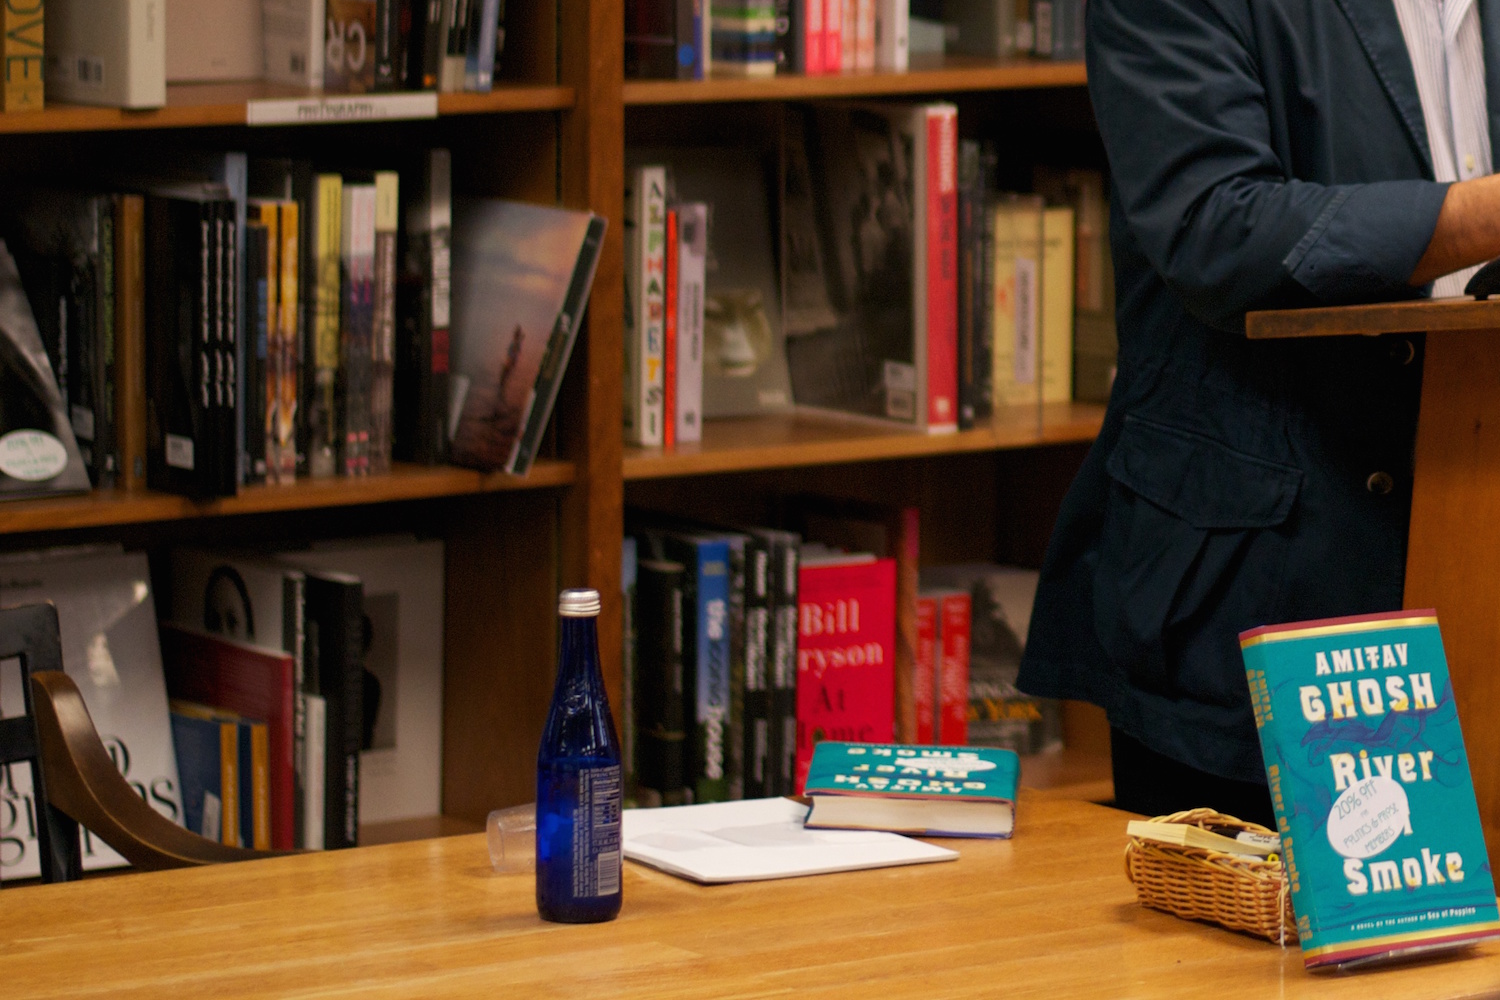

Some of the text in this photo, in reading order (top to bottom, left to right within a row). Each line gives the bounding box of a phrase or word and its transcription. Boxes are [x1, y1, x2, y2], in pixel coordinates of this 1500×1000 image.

[799, 598, 860, 637] Bill
[798, 642, 884, 679] ryson
[1315, 642, 1408, 676] AMITAV
[812, 683, 847, 713] At
[1257, 669, 1274, 721] AMITAV
[1299, 672, 1438, 722] GHOSH
[847, 748, 980, 761] Smoke
[1329, 748, 1434, 792] River
[834, 774, 987, 791] GHOSH
[852, 763, 969, 779] River
[854, 782, 963, 794] AMITAV
[1334, 792, 1362, 821] 20%
[1268, 763, 1301, 893] River of Smoke
[1364, 826, 1396, 853] MEMBERS
[1343, 847, 1465, 896] Smoke
[1397, 915, 1419, 924] AUTHOR
[1427, 911, 1440, 920] Sea
[1449, 906, 1476, 919] Poppies
